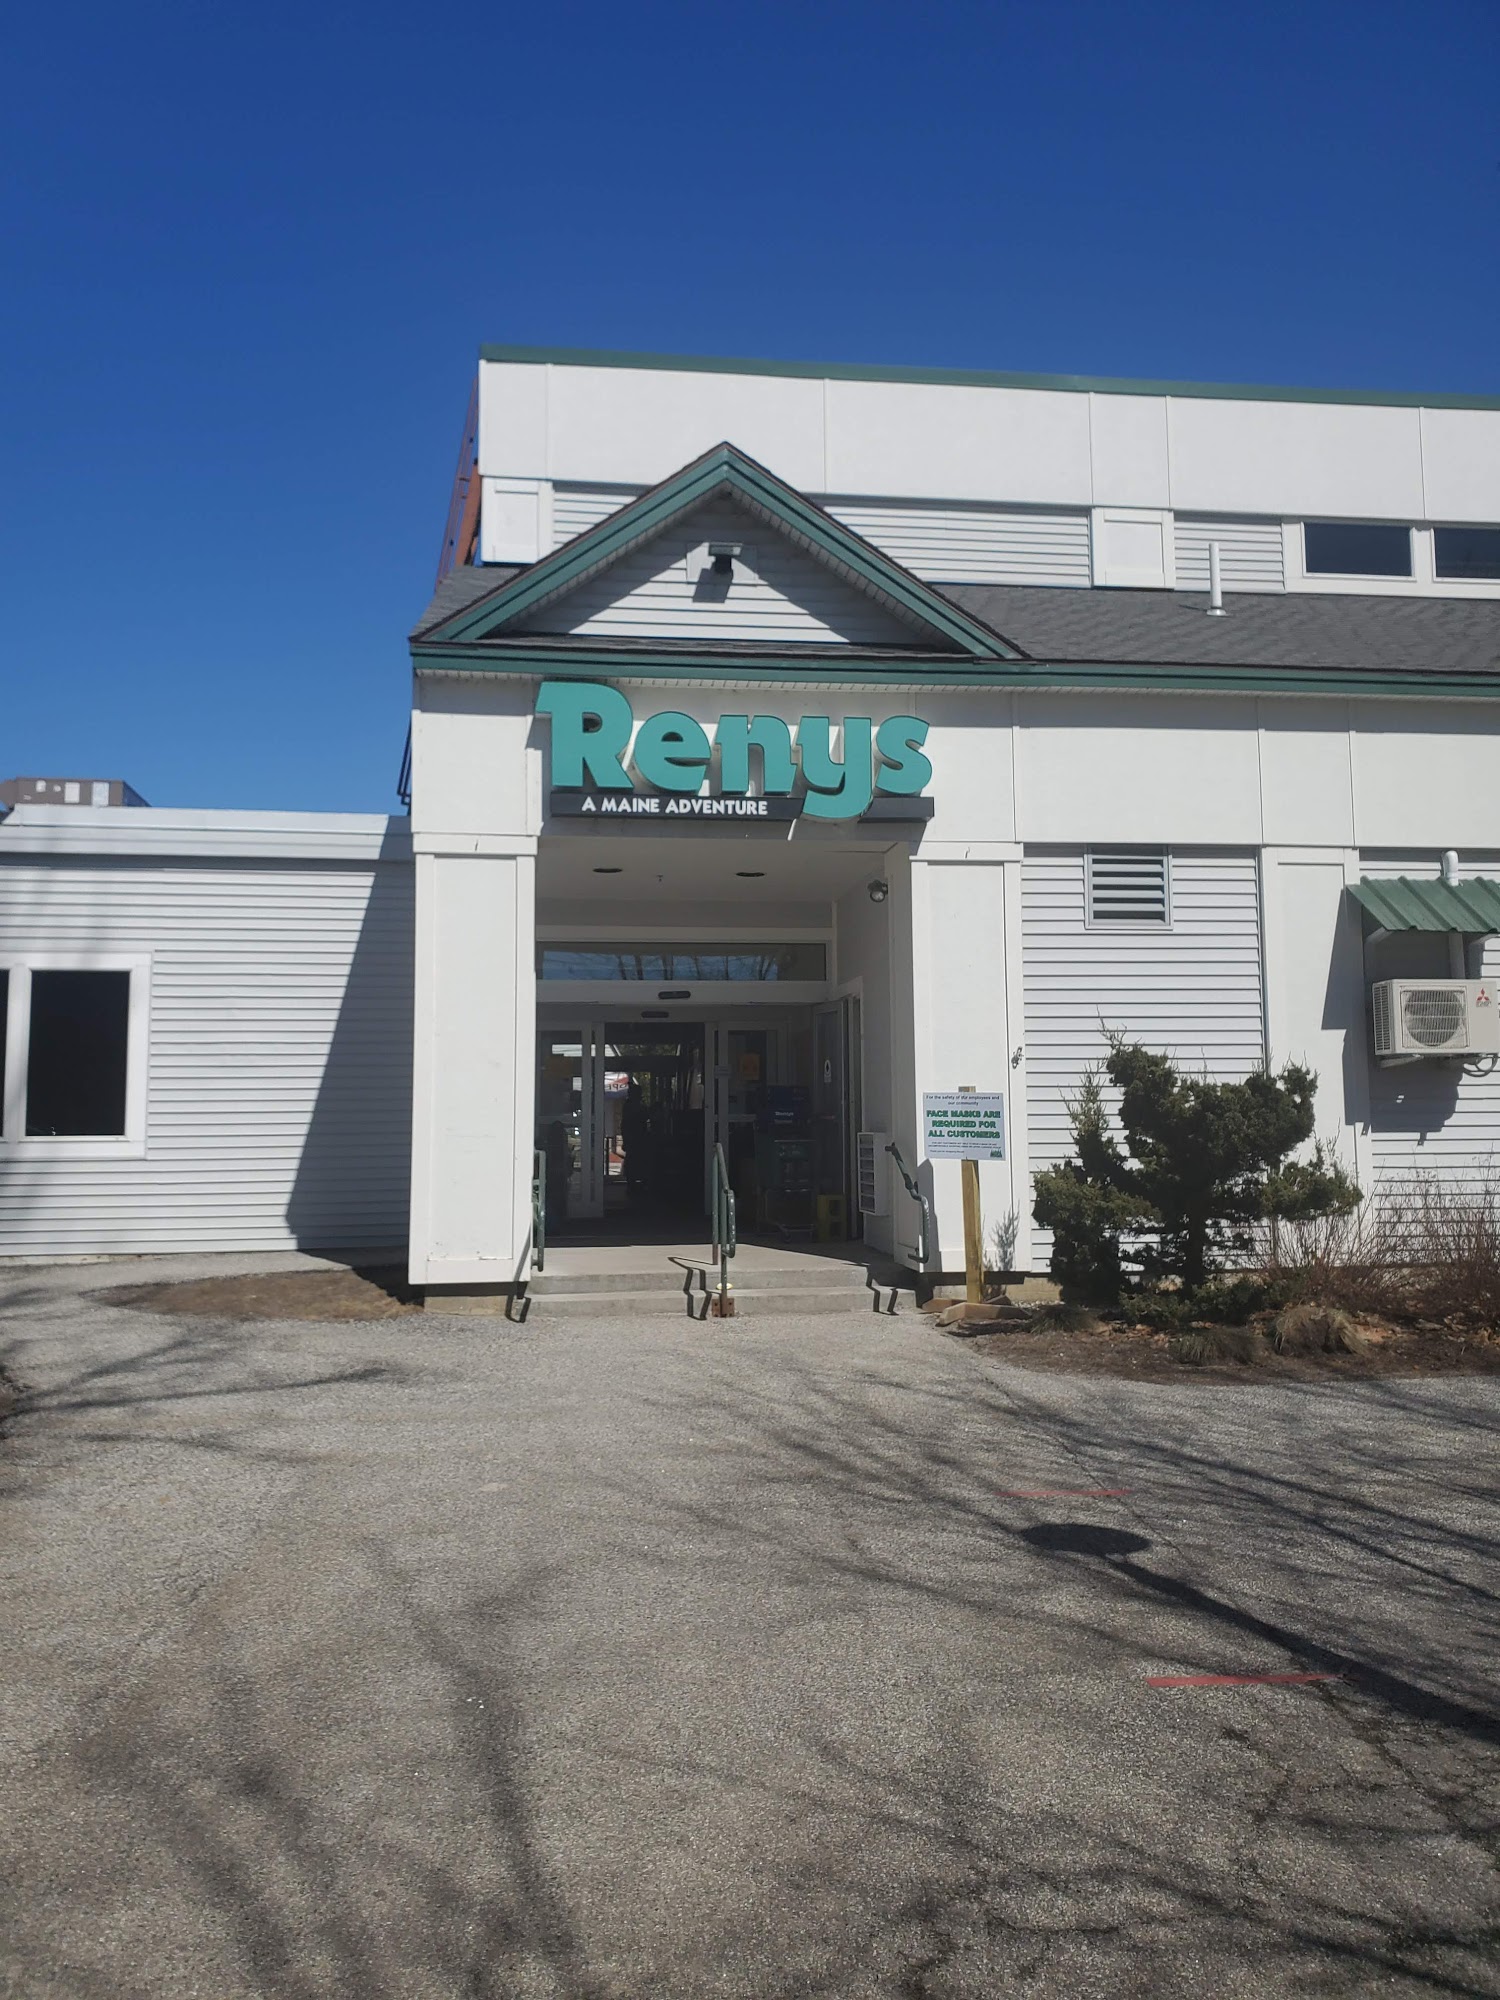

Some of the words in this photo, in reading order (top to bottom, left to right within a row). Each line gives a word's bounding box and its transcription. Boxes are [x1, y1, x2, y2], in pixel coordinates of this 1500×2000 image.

[535, 681, 933, 819] Renys
[581, 796, 596, 812] A
[601, 797, 660, 813] MAINE
[665, 798, 768, 815] ADVENTURE
[926, 1110, 949, 1118] FACE
[951, 1110, 981, 1118] MASKS
[983, 1110, 1001, 1118] ARE
[932, 1120, 977, 1128] REQUIRED
[928, 1130, 945, 1138] ALL
[947, 1130, 1001, 1139] CUSTOMERS
